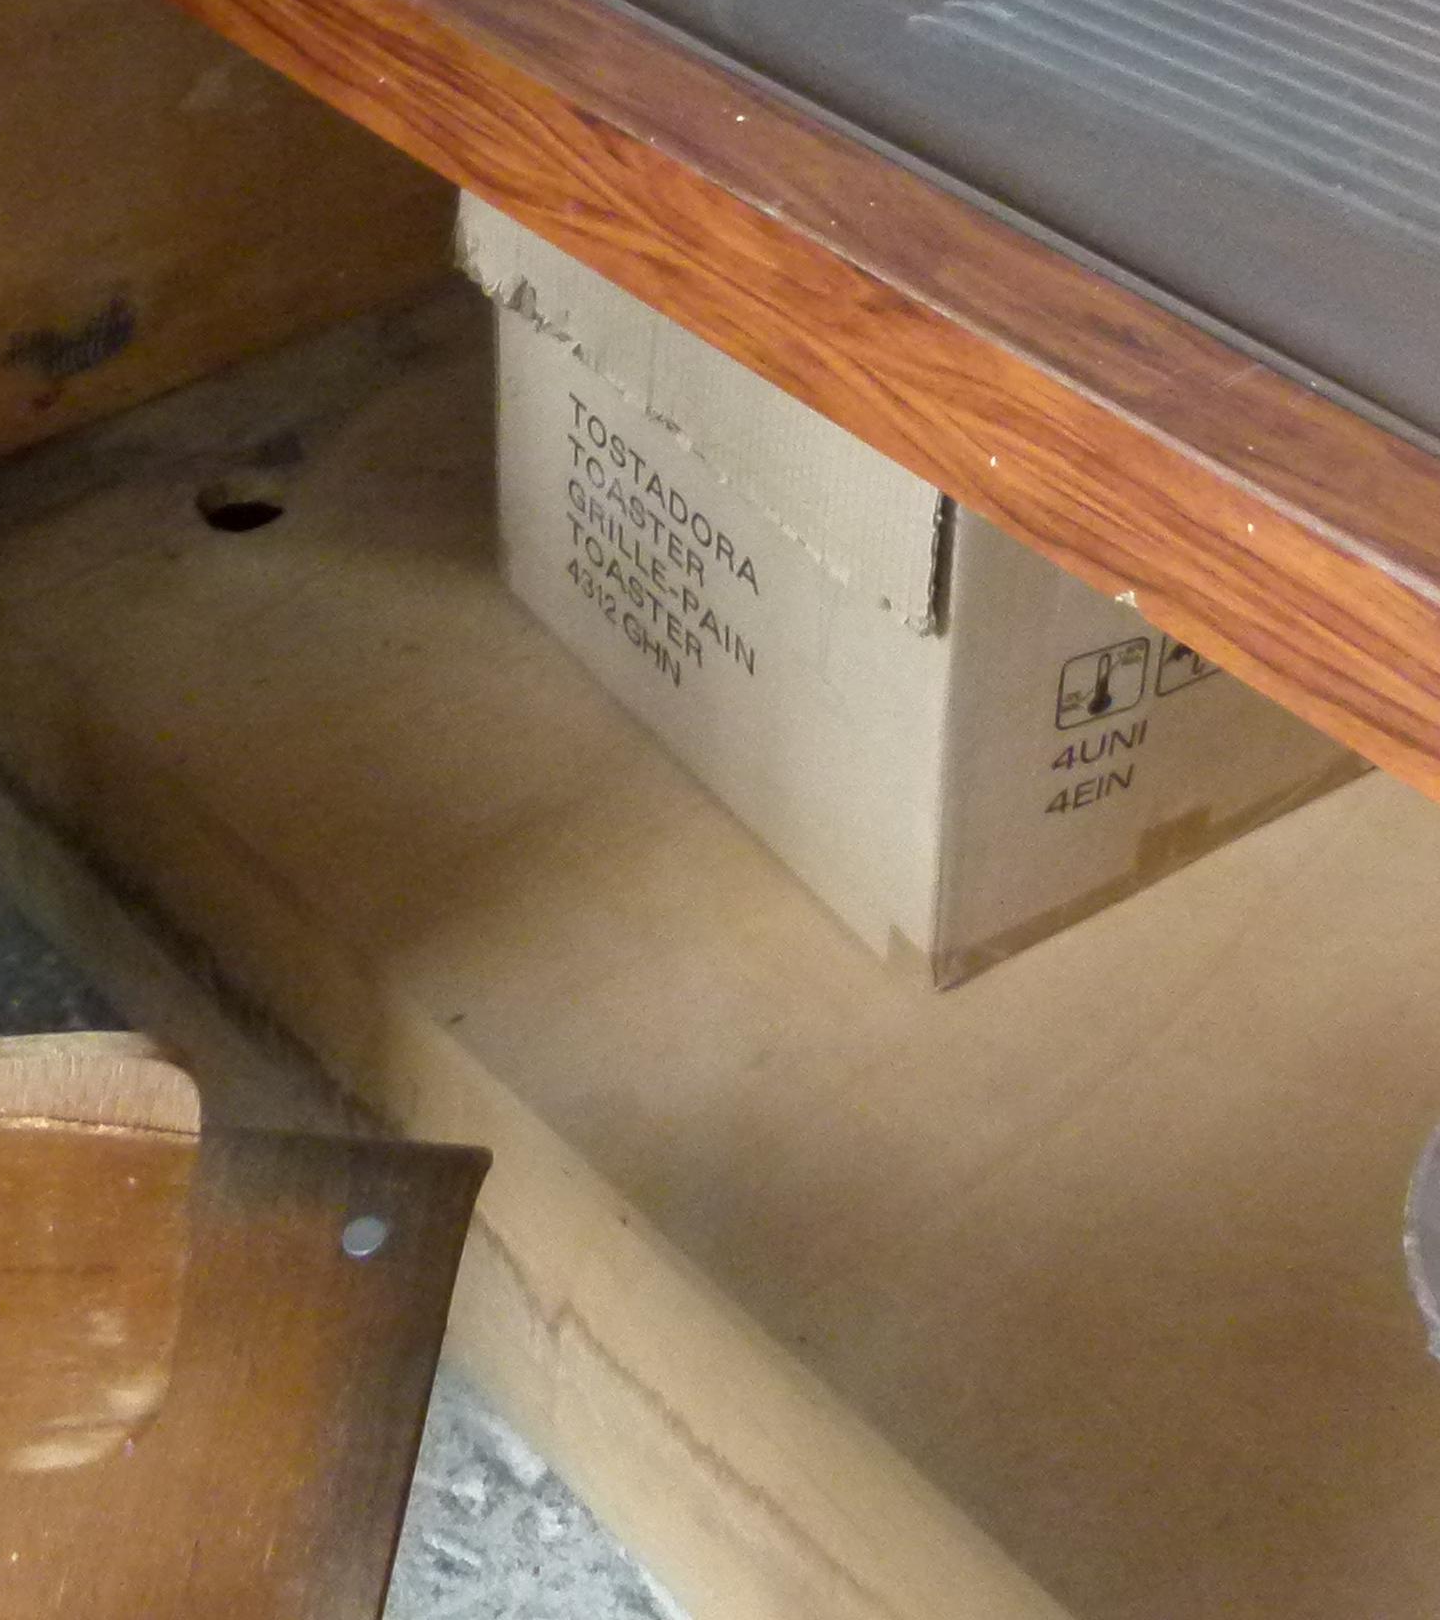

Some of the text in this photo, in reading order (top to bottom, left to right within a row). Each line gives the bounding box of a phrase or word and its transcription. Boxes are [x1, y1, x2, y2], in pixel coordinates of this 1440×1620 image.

[568, 433, 704, 587] TOASTER
[569, 392, 758, 595] TOSTADORA
[569, 480, 754, 676] GRILLE-PAIN
[567, 511, 703, 669] TOASTER
